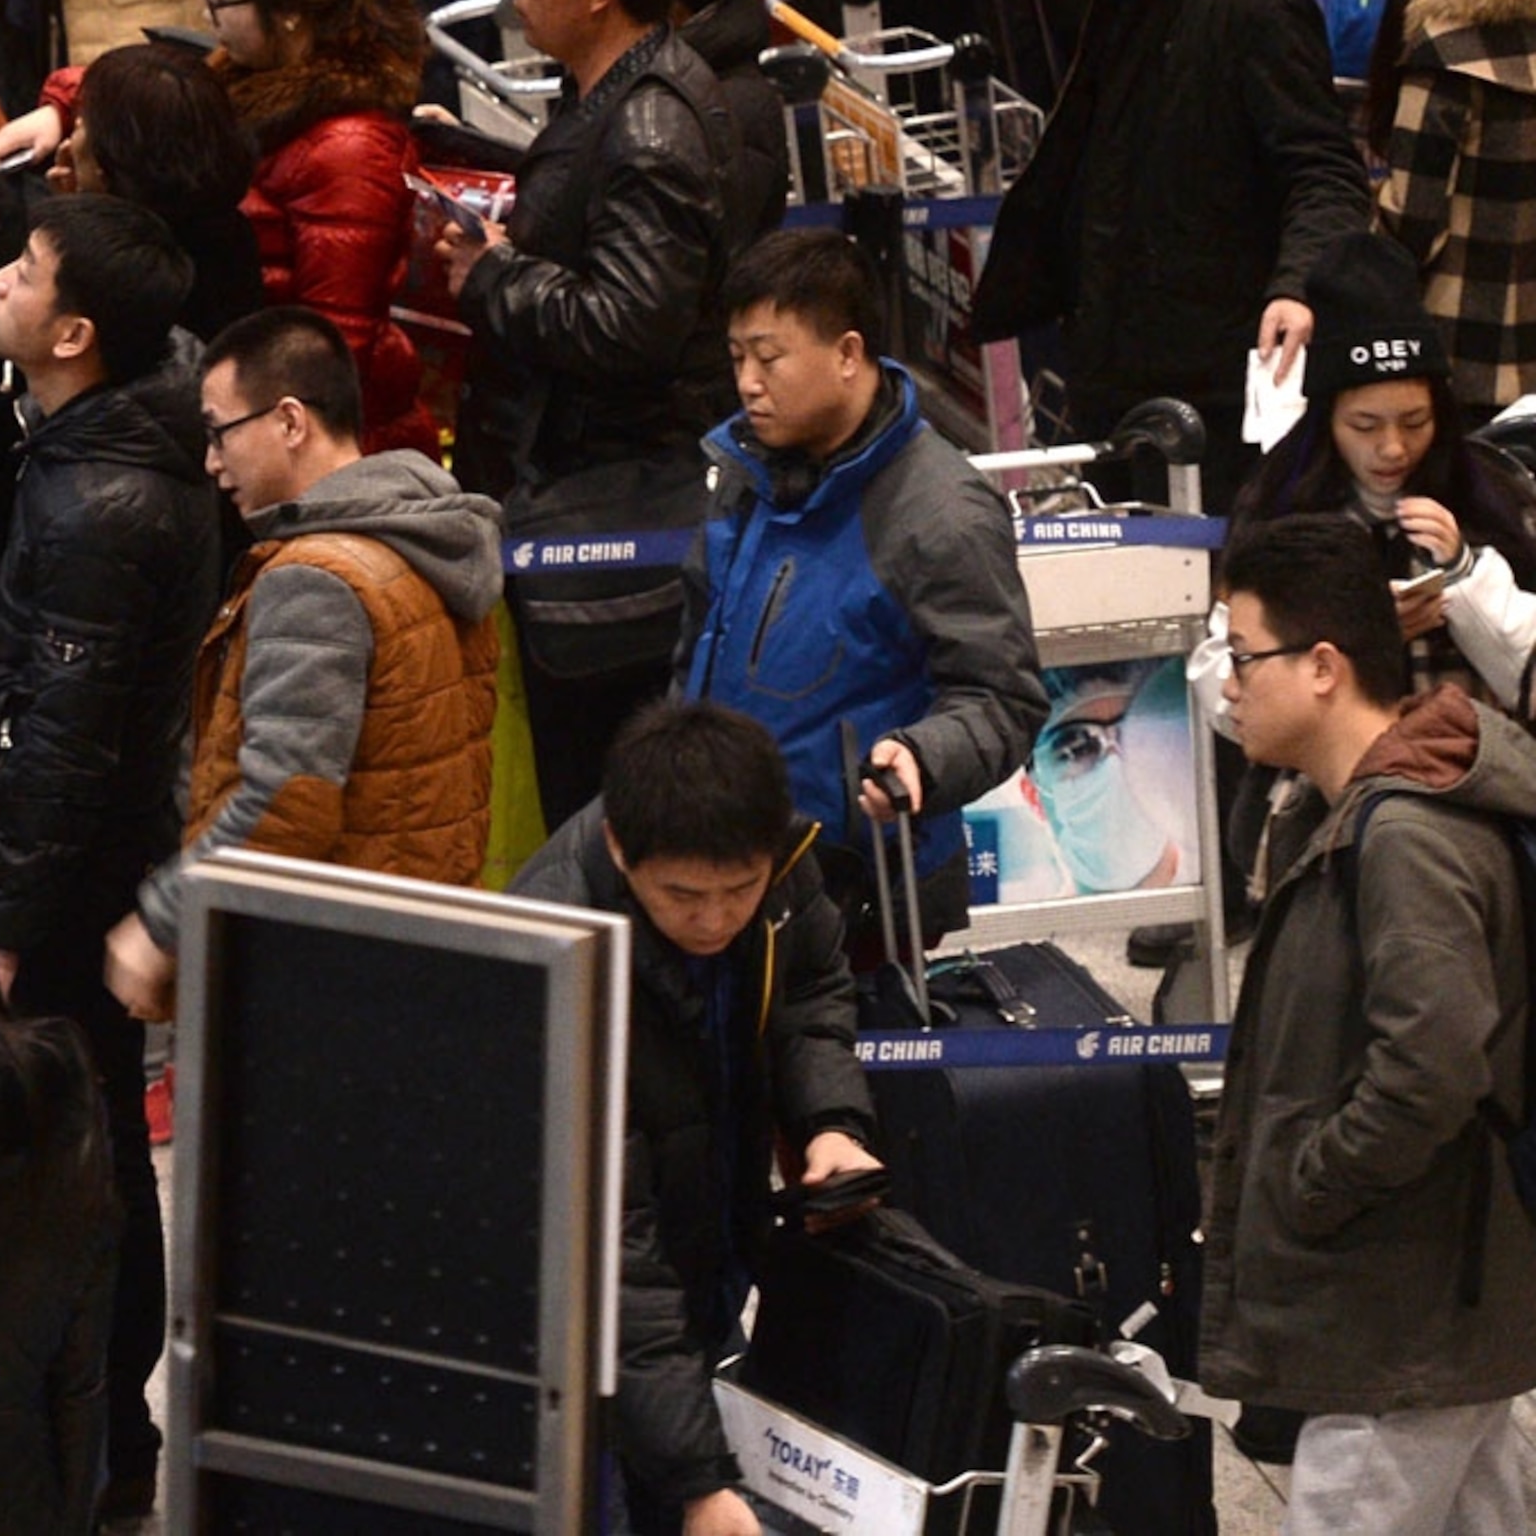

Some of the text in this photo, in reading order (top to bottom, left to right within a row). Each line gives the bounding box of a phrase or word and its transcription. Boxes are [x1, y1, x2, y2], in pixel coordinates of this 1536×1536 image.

[1349, 339, 1421, 365] OBEY
[1033, 521, 1123, 540] AIR CHINA
[542, 541, 636, 564] AIR CHINA
[854, 1040, 943, 1061] IR CHINA
[1107, 1033, 1211, 1056] AIR CHINA
